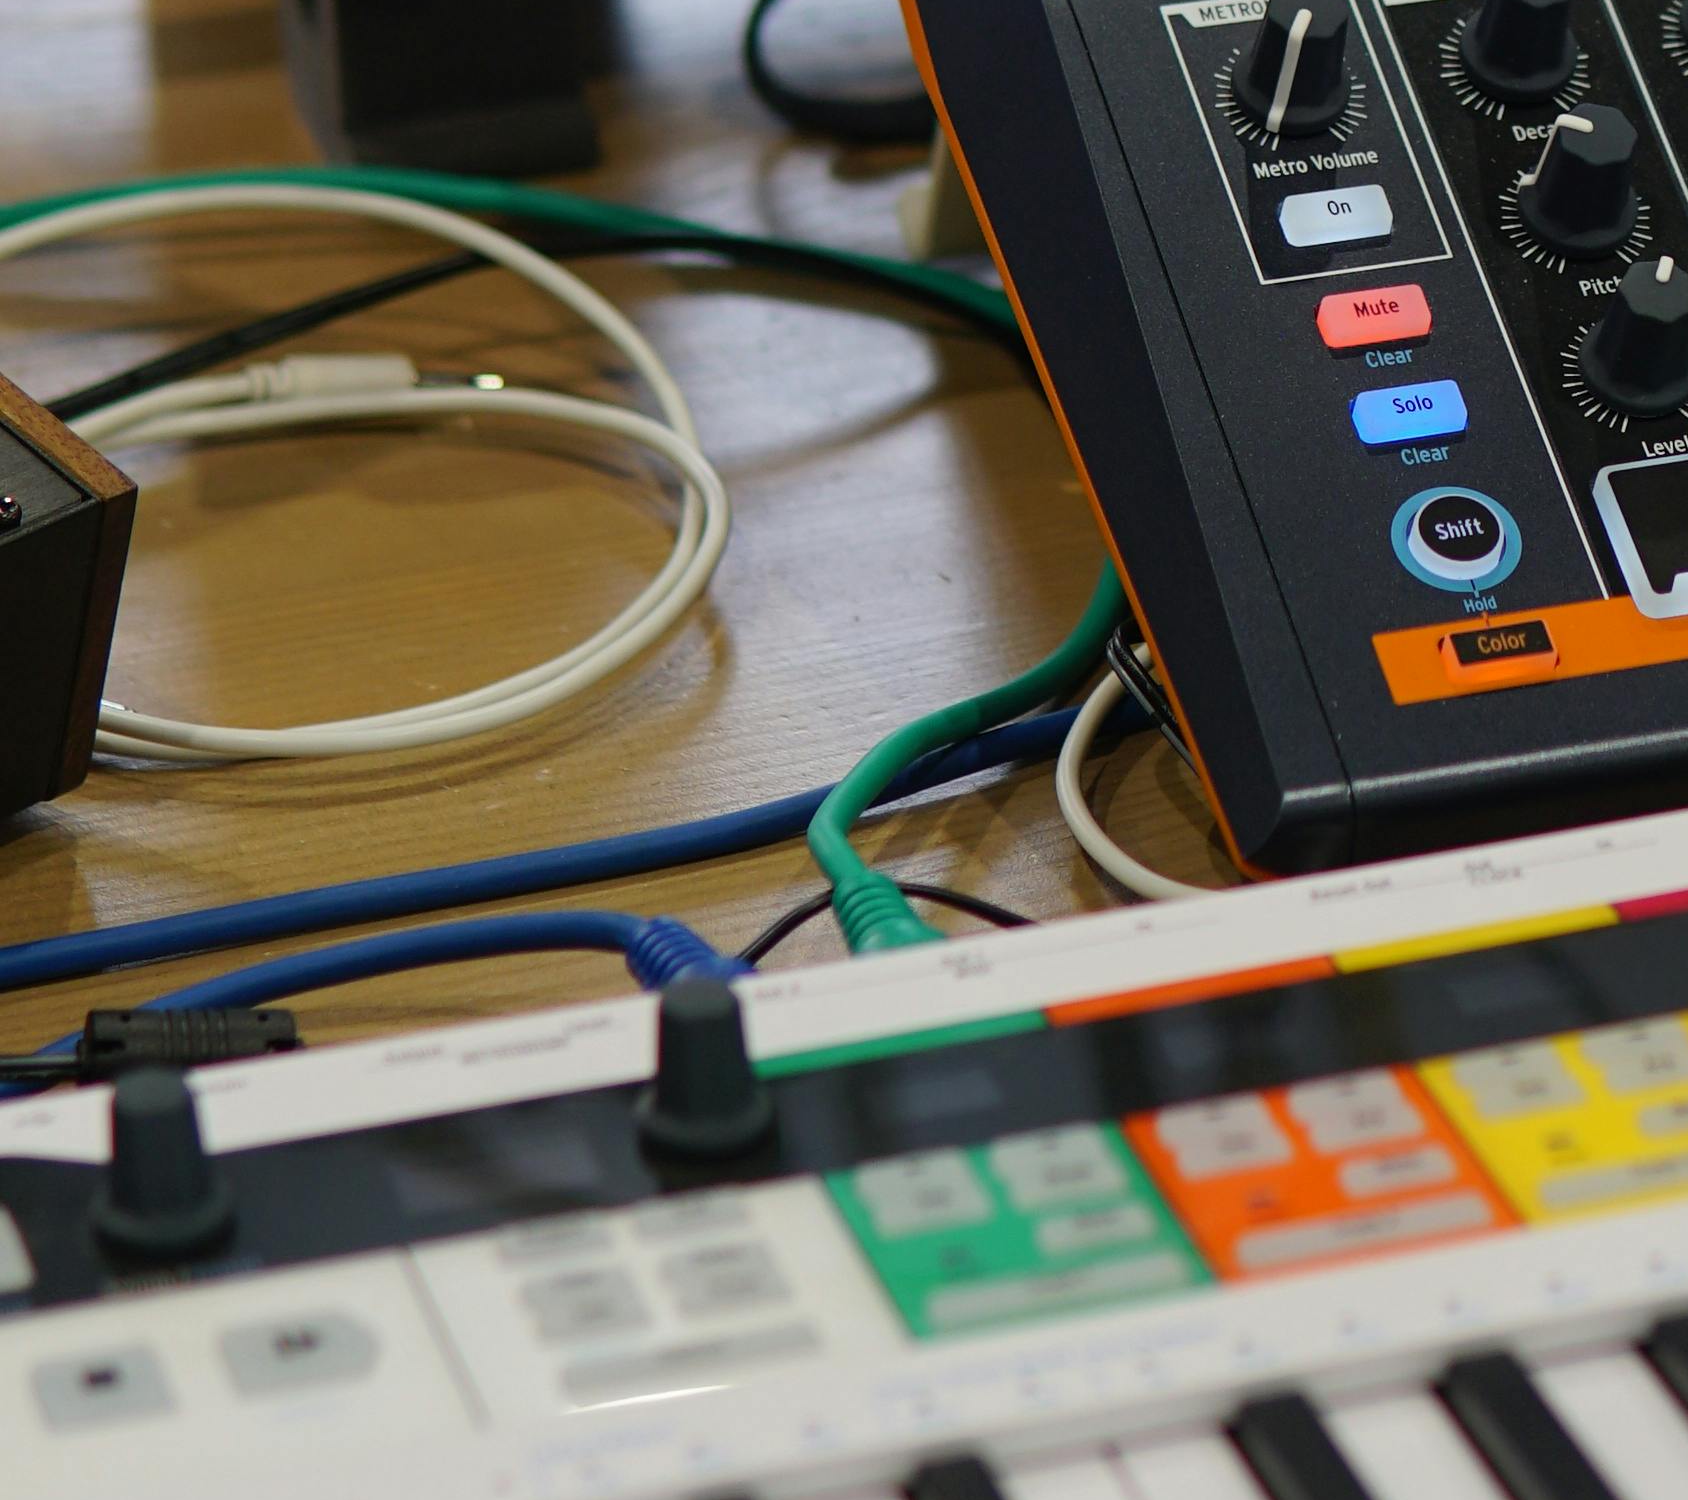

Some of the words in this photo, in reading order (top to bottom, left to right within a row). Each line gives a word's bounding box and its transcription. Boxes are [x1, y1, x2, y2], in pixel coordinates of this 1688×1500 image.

[1199, 1, 1270, 22] METRO
[1512, 123, 1556, 142] Deca
[1253, 156, 1308, 180] Metro
[1310, 149, 1379, 172] Volume
[1327, 199, 1352, 216] On
[1353, 298, 1400, 319] Mute
[1365, 349, 1413, 368] Clear
[1392, 395, 1434, 414] Solo
[1401, 446, 1449, 466] Clear
[1434, 517, 1485, 541] Shift
[1463, 595, 1498, 613] Hold
[1477, 632, 1528, 654] Color
